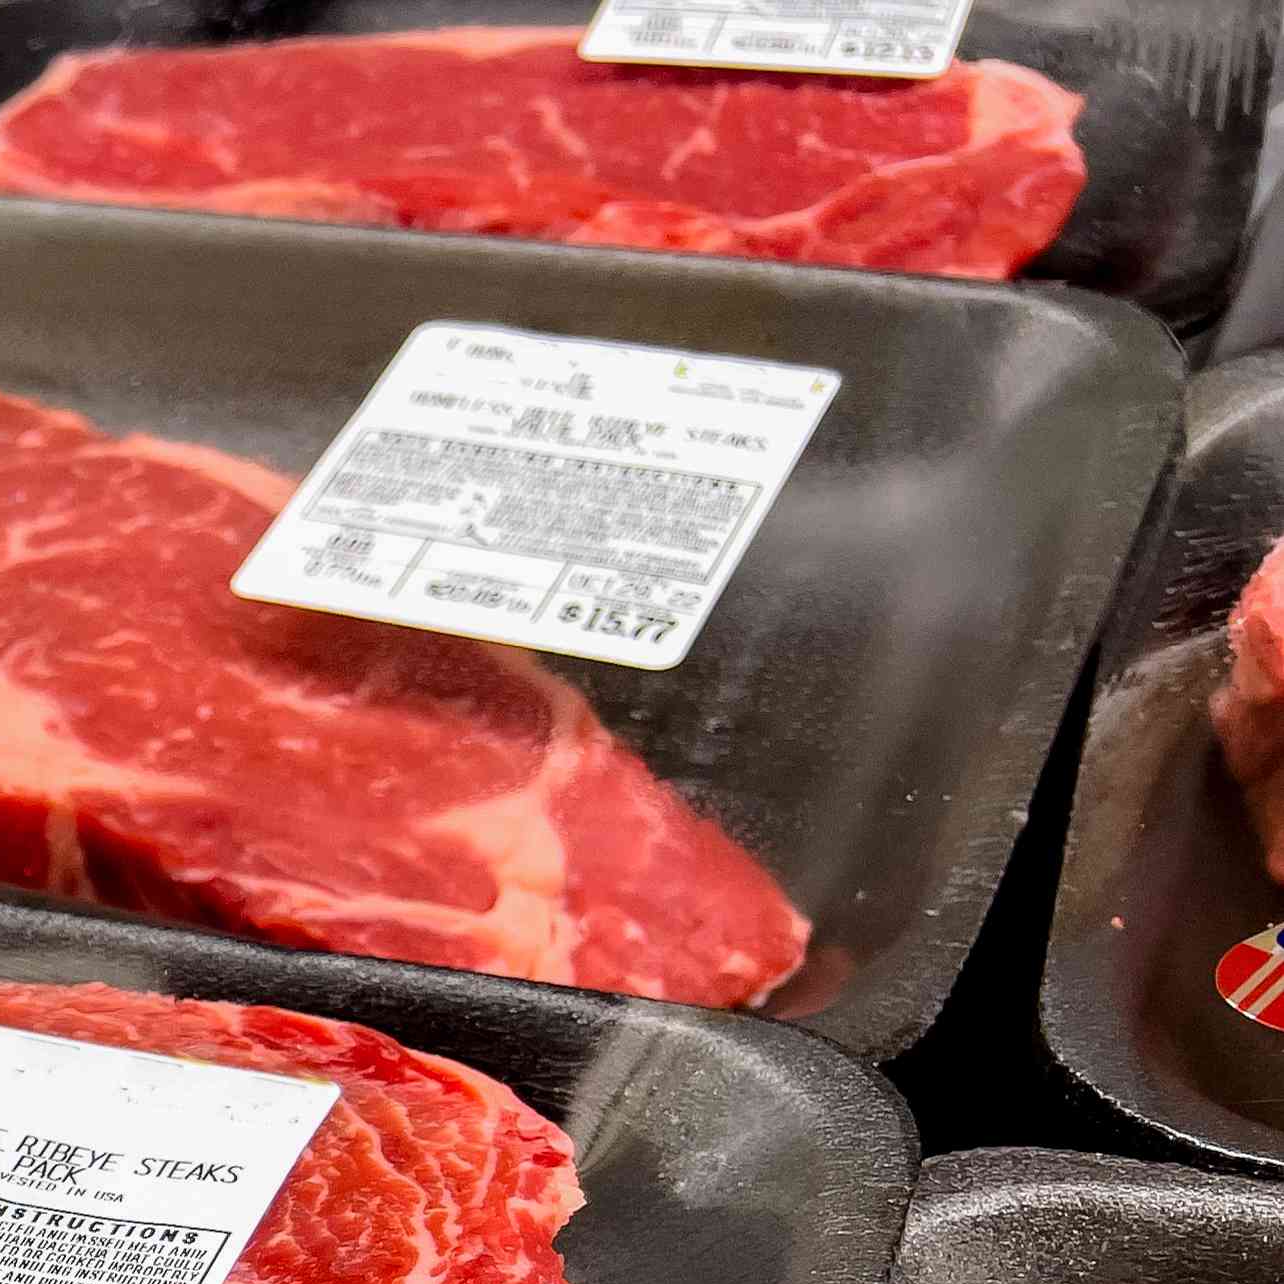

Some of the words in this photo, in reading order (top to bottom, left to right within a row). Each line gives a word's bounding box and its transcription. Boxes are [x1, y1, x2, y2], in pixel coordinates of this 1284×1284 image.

[557, 600, 679, 643] $15.77
[11, 1154, 86, 1185] PACK
[15, 1135, 123, 1170] RIBEYE
[133, 1157, 243, 1183] STEAKS
